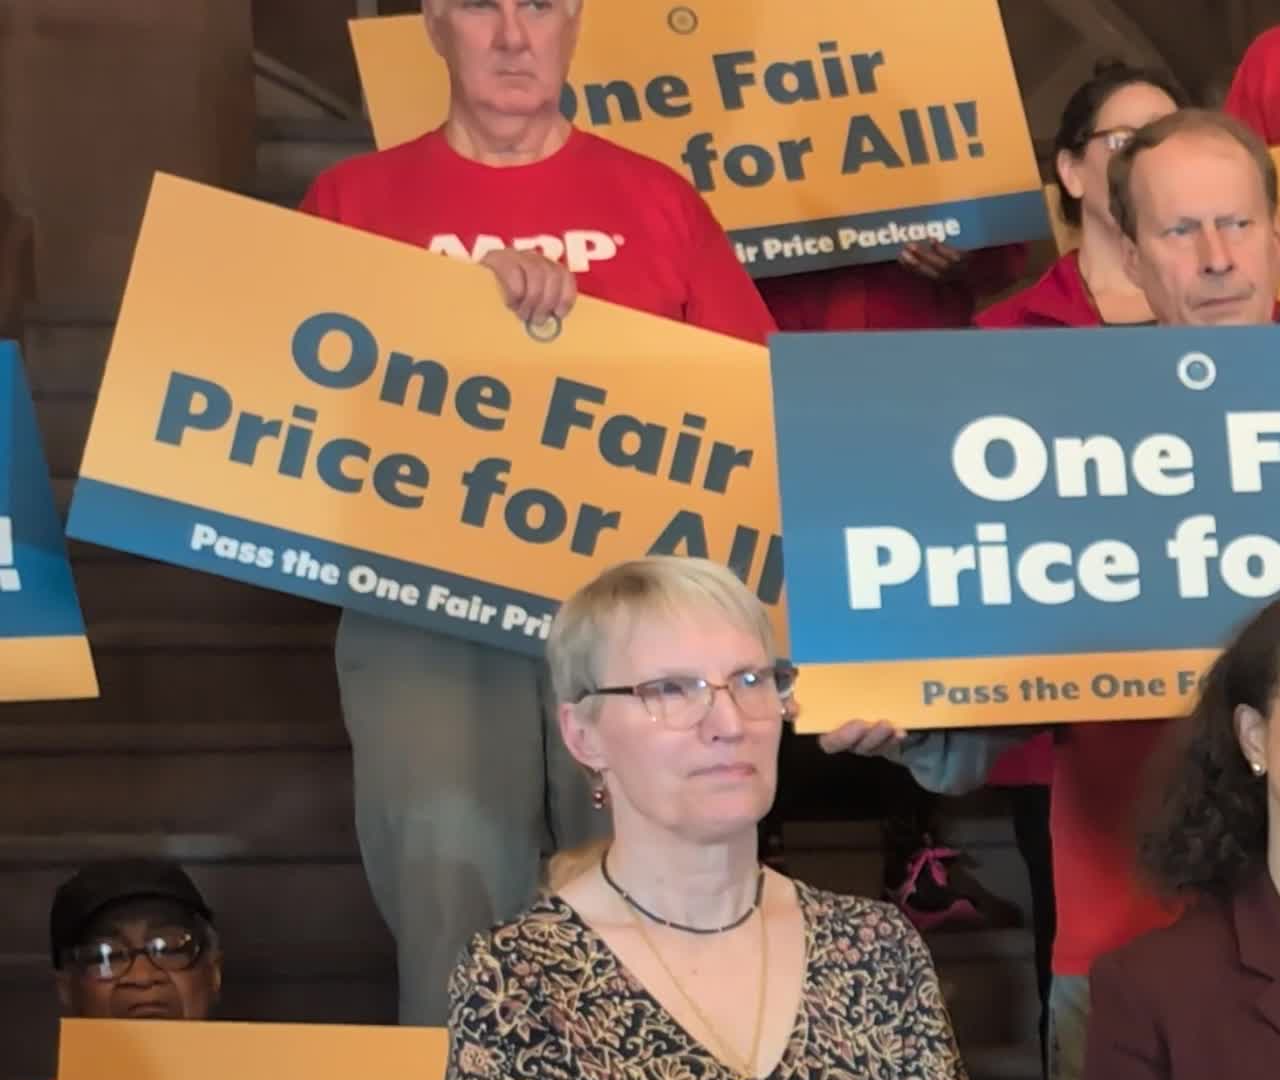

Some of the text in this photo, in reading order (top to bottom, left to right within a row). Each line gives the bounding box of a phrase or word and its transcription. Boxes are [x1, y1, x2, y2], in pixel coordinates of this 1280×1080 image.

[558, 41, 885, 126] ne Fair
[682, 101, 985, 193] for All!
[762, 234, 835, 260] Price
[838, 217, 961, 251] Package
[291, 312, 754, 494] One Fair
[155, 371, 784, 605] Price for All
[952, 415, 1196, 501] One
[191, 523, 552, 640] Pass the One Fair Pri
[844, 523, 1141, 610] Price
[922, 680, 1010, 705] Pass
[1019, 677, 1080, 701] the
[1091, 672, 1166, 699] One
